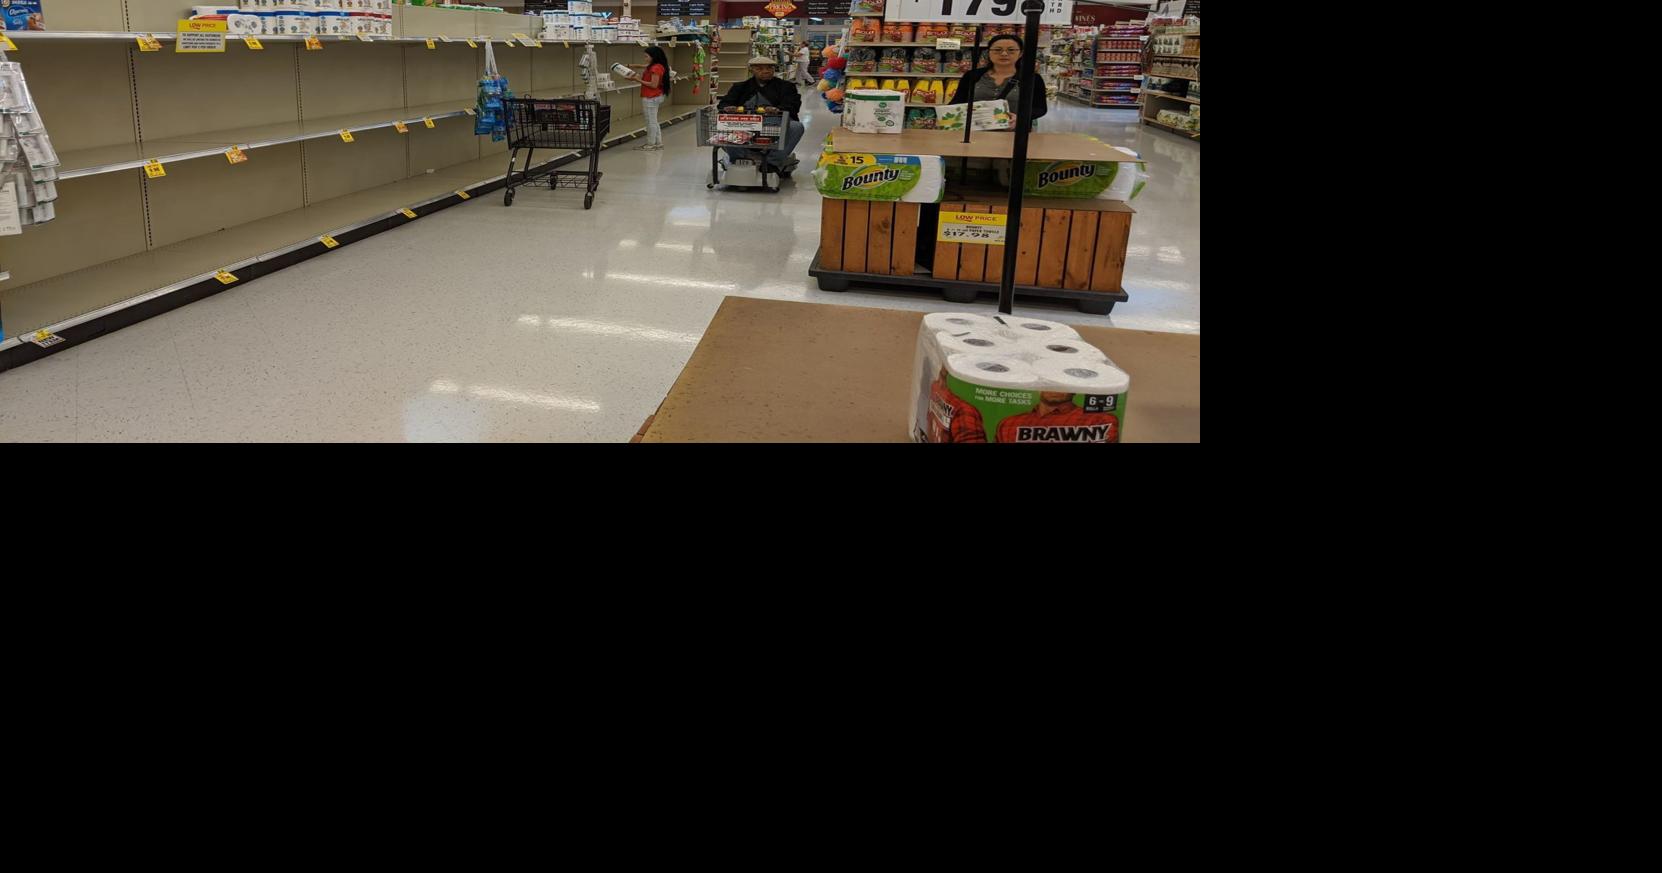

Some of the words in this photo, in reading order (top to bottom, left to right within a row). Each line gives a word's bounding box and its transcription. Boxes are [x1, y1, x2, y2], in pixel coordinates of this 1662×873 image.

[941, 0, 1046, 17] 179
[851, 156, 864, 164] 15
[841, 168, 900, 191] Bounty
[1038, 164, 1096, 188] Bounty
[975, 387, 998, 397] MORE
[999, 391, 1033, 399] CHOICES
[1008, 398, 1032, 406] TASKS
[1089, 396, 1097, 406] 6
[1105, 395, 1114, 407] 9
[1017, 424, 1111, 442] BRAWNY
